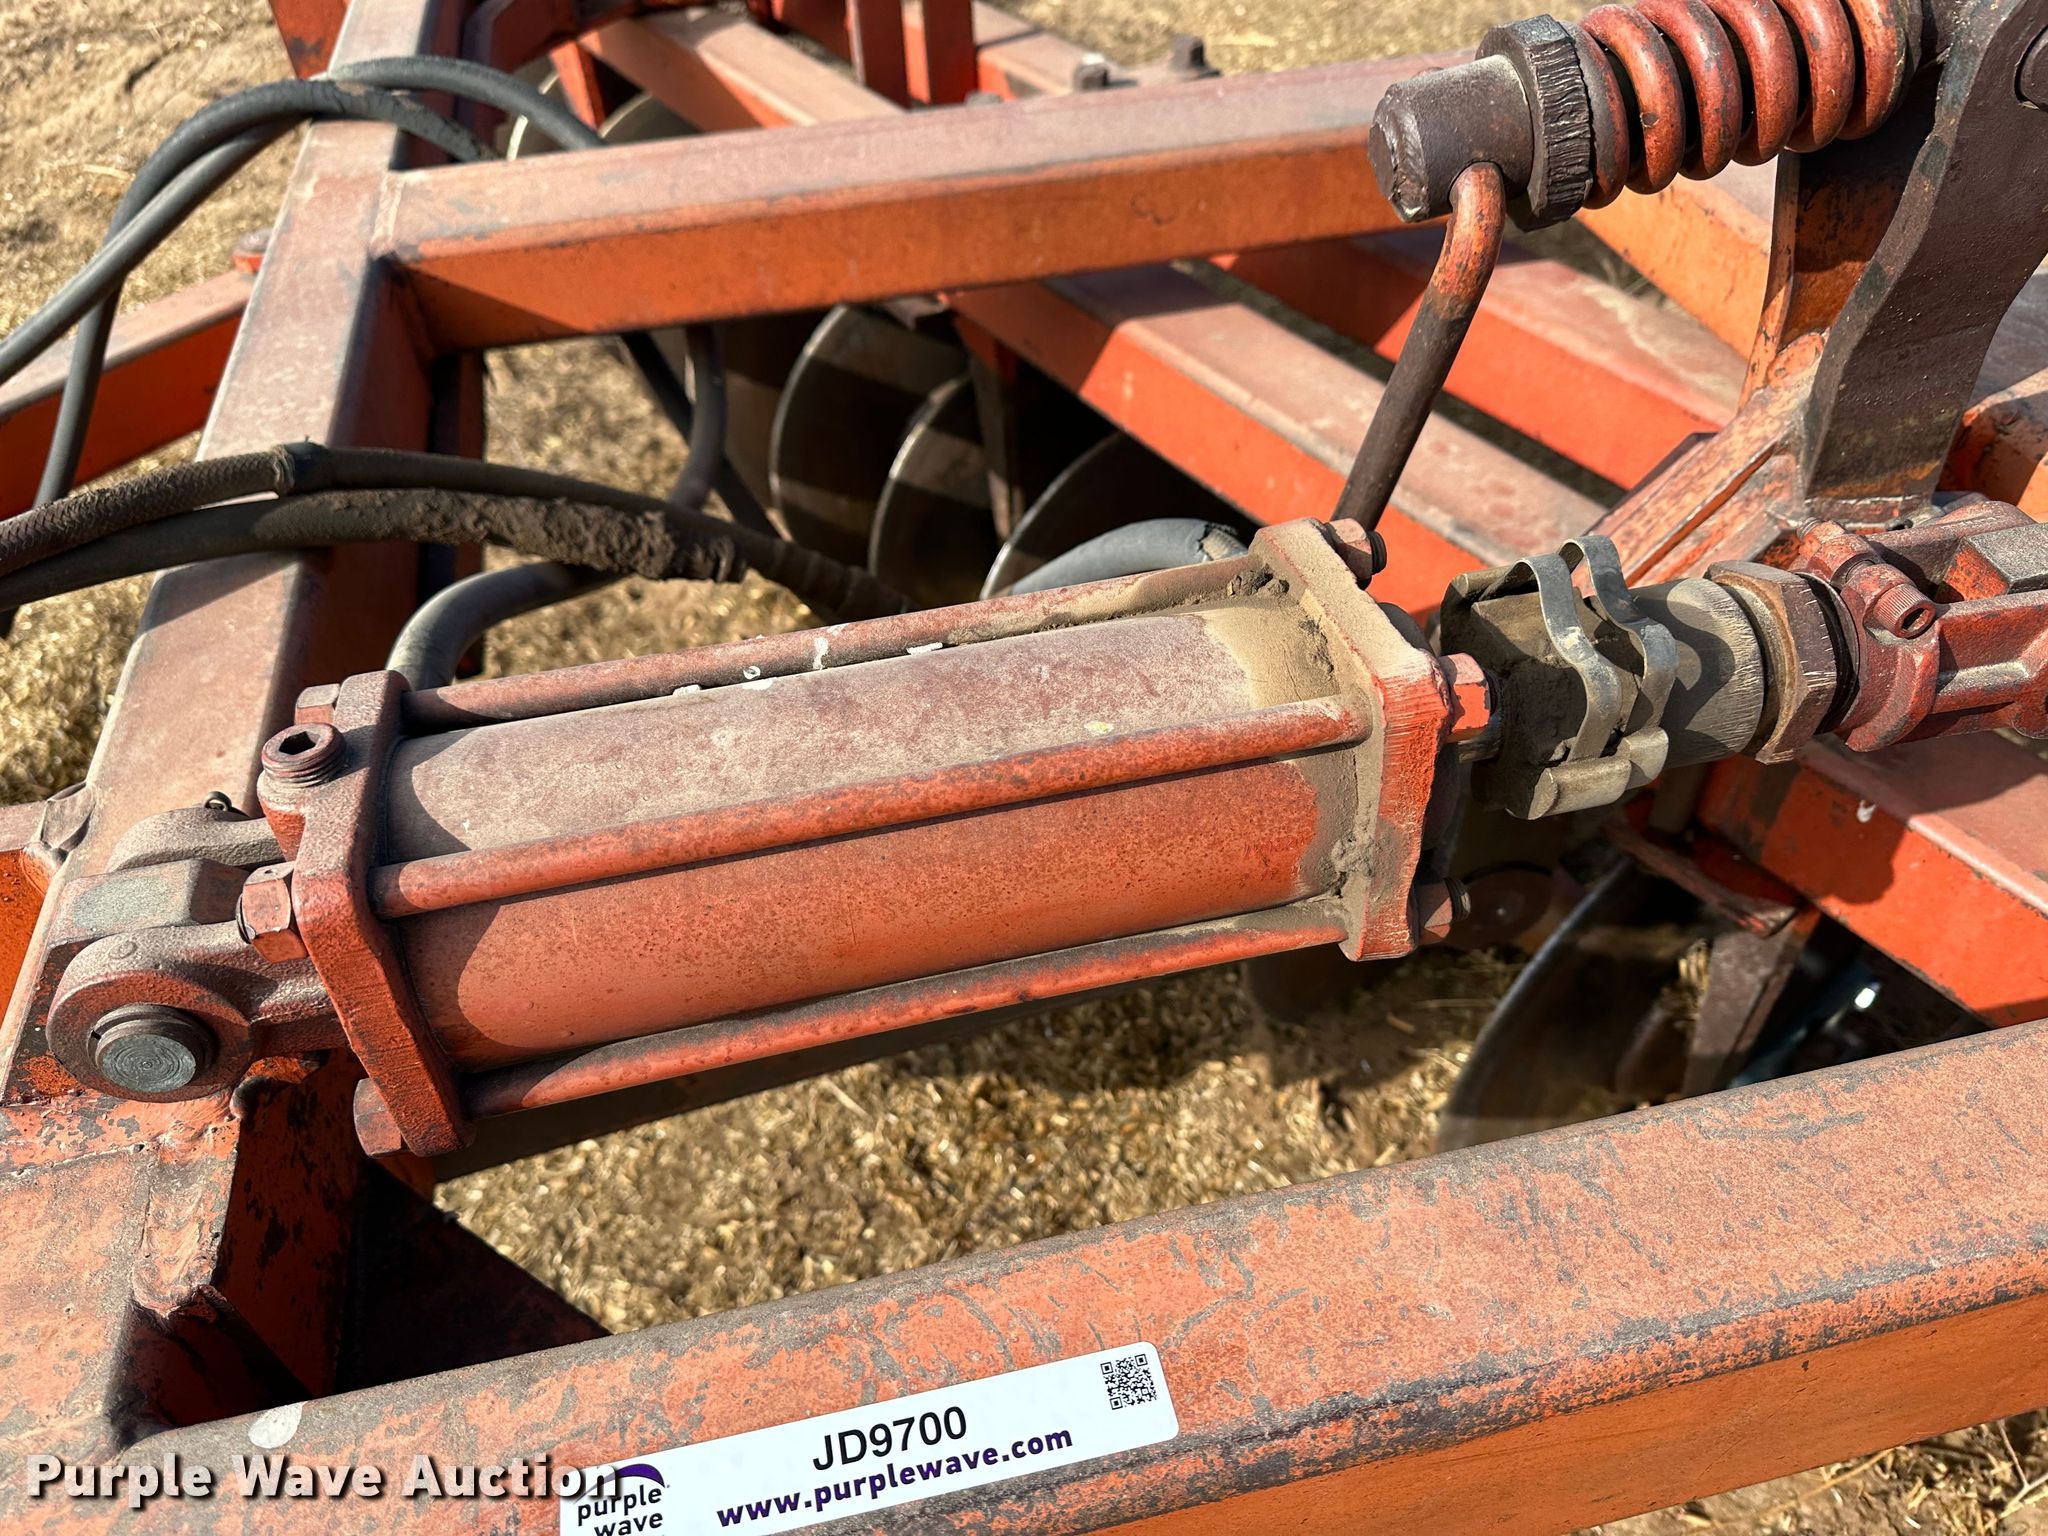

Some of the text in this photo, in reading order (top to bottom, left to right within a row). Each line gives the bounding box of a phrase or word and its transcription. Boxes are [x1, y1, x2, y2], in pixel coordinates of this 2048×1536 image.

[812, 1405, 967, 1471] JD9700
[716, 1429, 1073, 1527] www.purplewave.com
[577, 1484, 663, 1527] purple
[594, 1512, 664, 1536] wave
